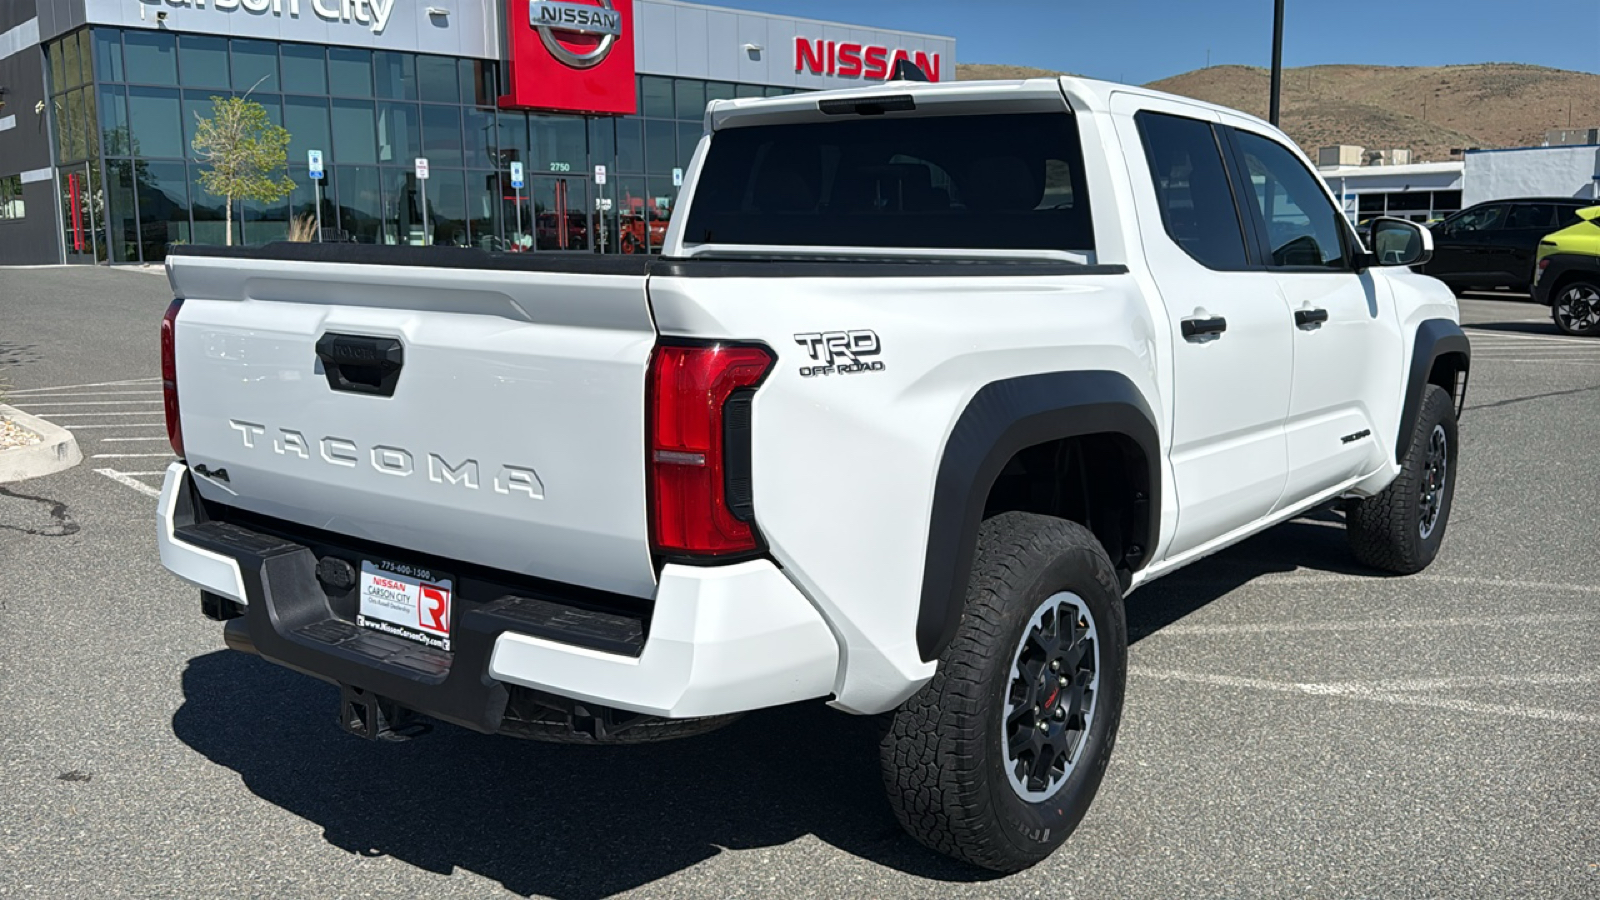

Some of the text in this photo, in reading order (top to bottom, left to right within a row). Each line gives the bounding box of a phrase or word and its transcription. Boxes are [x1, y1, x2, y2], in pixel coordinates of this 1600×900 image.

[541, 6, 615, 29] NISSAN
[550, 162, 570, 172] 2750
[334, 344, 376, 360] TOYOTA
[793, 329, 881, 365] TRD
[800, 361, 885, 377] OFF ROAD
[229, 419, 545, 500] TACOMA
[381, 560, 430, 579] 775-600-1500
[373, 577, 406, 592] NISSAN
[368, 585, 396, 600] CARSON
[396, 592, 411, 604] CITY
[365, 620, 442, 646] www.NissanCarsonCity.com
